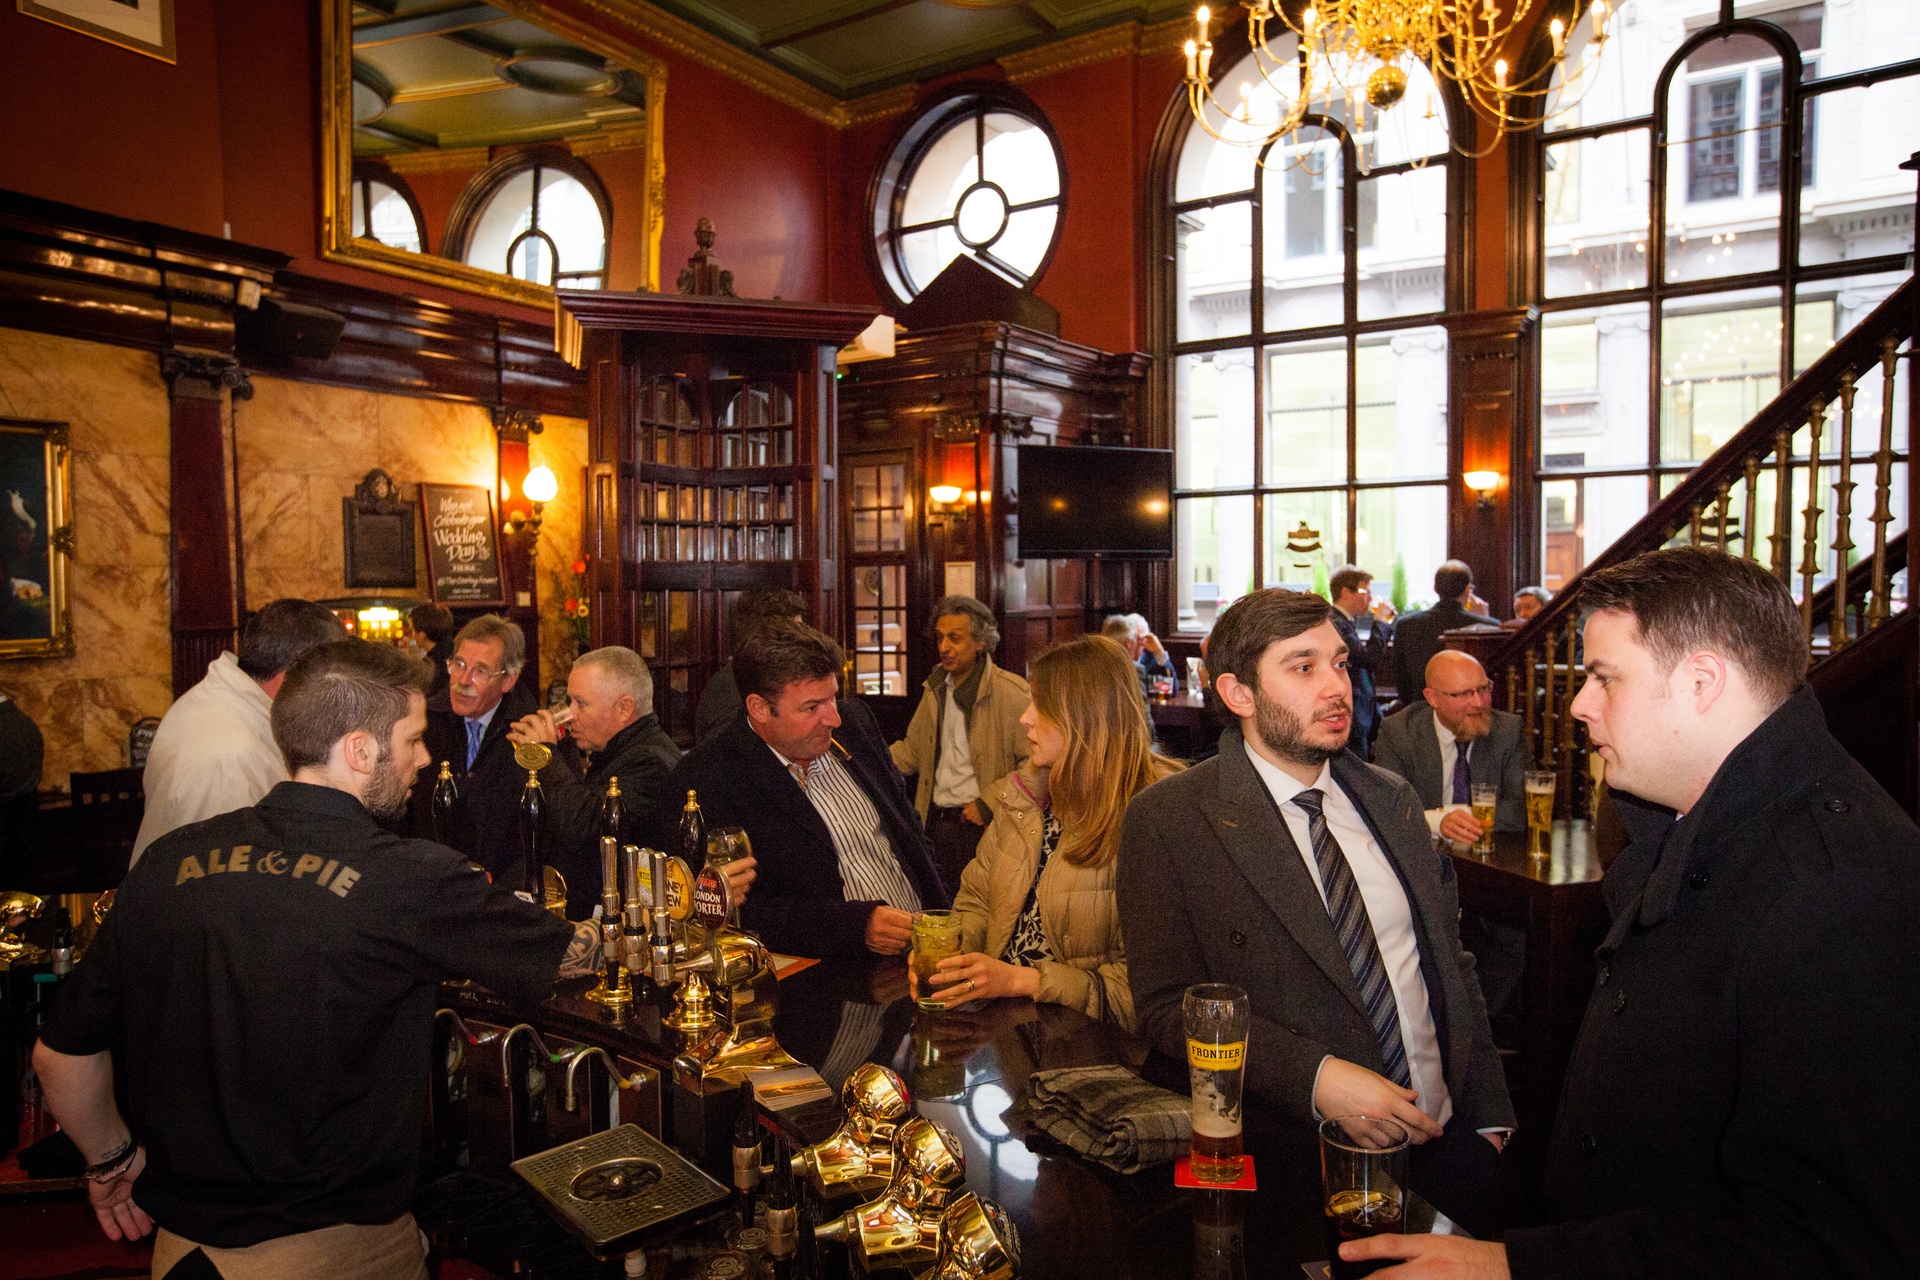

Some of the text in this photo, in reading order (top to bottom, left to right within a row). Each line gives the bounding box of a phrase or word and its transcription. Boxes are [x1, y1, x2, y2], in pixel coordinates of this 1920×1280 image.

[440, 497, 474, 513] Why not
[434, 527, 486, 547] Wedding
[446, 545, 475, 562] Day
[175, 845, 362, 898] ALE & PIE
[667, 880, 685, 894] NEY
[667, 895, 682, 907] EW
[694, 890, 721, 904] LONDON
[1191, 1045, 1240, 1059] FRONTIER
